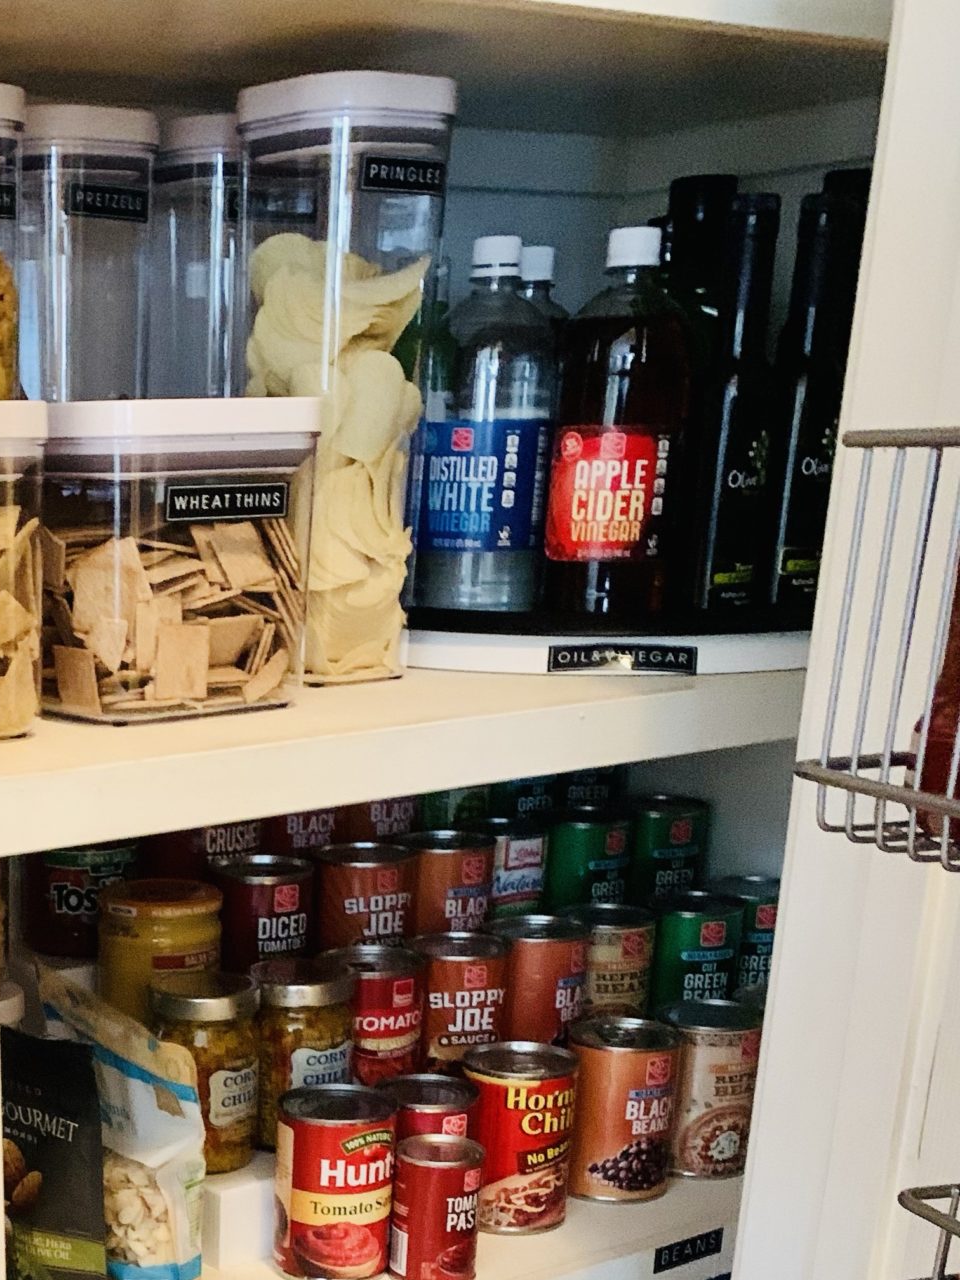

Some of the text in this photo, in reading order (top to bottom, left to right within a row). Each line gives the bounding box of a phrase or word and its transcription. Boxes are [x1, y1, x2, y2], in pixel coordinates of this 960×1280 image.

[368, 162, 442, 185] PRINGLES
[428, 455, 499, 483] DISTILLED
[573, 459, 649, 490] APPLE
[173, 488, 283, 511] WHEAT THINS
[428, 482, 496, 513] WHITE
[571, 488, 645, 522] CIDER
[428, 511, 491, 533] VINEGAR
[570, 520, 642, 542] VINEGAR
[286, 812, 336, 834] BLACK
[370, 801, 414, 823] BLACK
[292, 831, 331, 849] BEANS
[445, 895, 488, 919] BLACK
[257, 912, 308, 940] DICED
[362, 911, 405, 937] JOE
[741, 955, 773, 971] GREE
[684, 971, 730, 990] GREEN
[429, 988, 506, 1009] SLOPPY
[555, 983, 584, 1010] BLA
[448, 1006, 496, 1032] JOE
[560, 1005, 583, 1023] BEA
[450, 1034, 490, 1045] SAUCE
[306, 1048, 348, 1067] CORN
[506, 1086, 575, 1111] Horm
[625, 1096, 672, 1121] BLACK
[521, 1107, 574, 1136] Chil
[631, 1117, 669, 1135] BEANS
[319, 1151, 394, 1188] Hunt
[526, 1152, 545, 1165] No
[309, 1200, 373, 1217] Tomato
[446, 1193, 479, 1214] TOMA
[446, 1210, 476, 1233] PAS
[660, 1233, 718, 1266] BEANS
